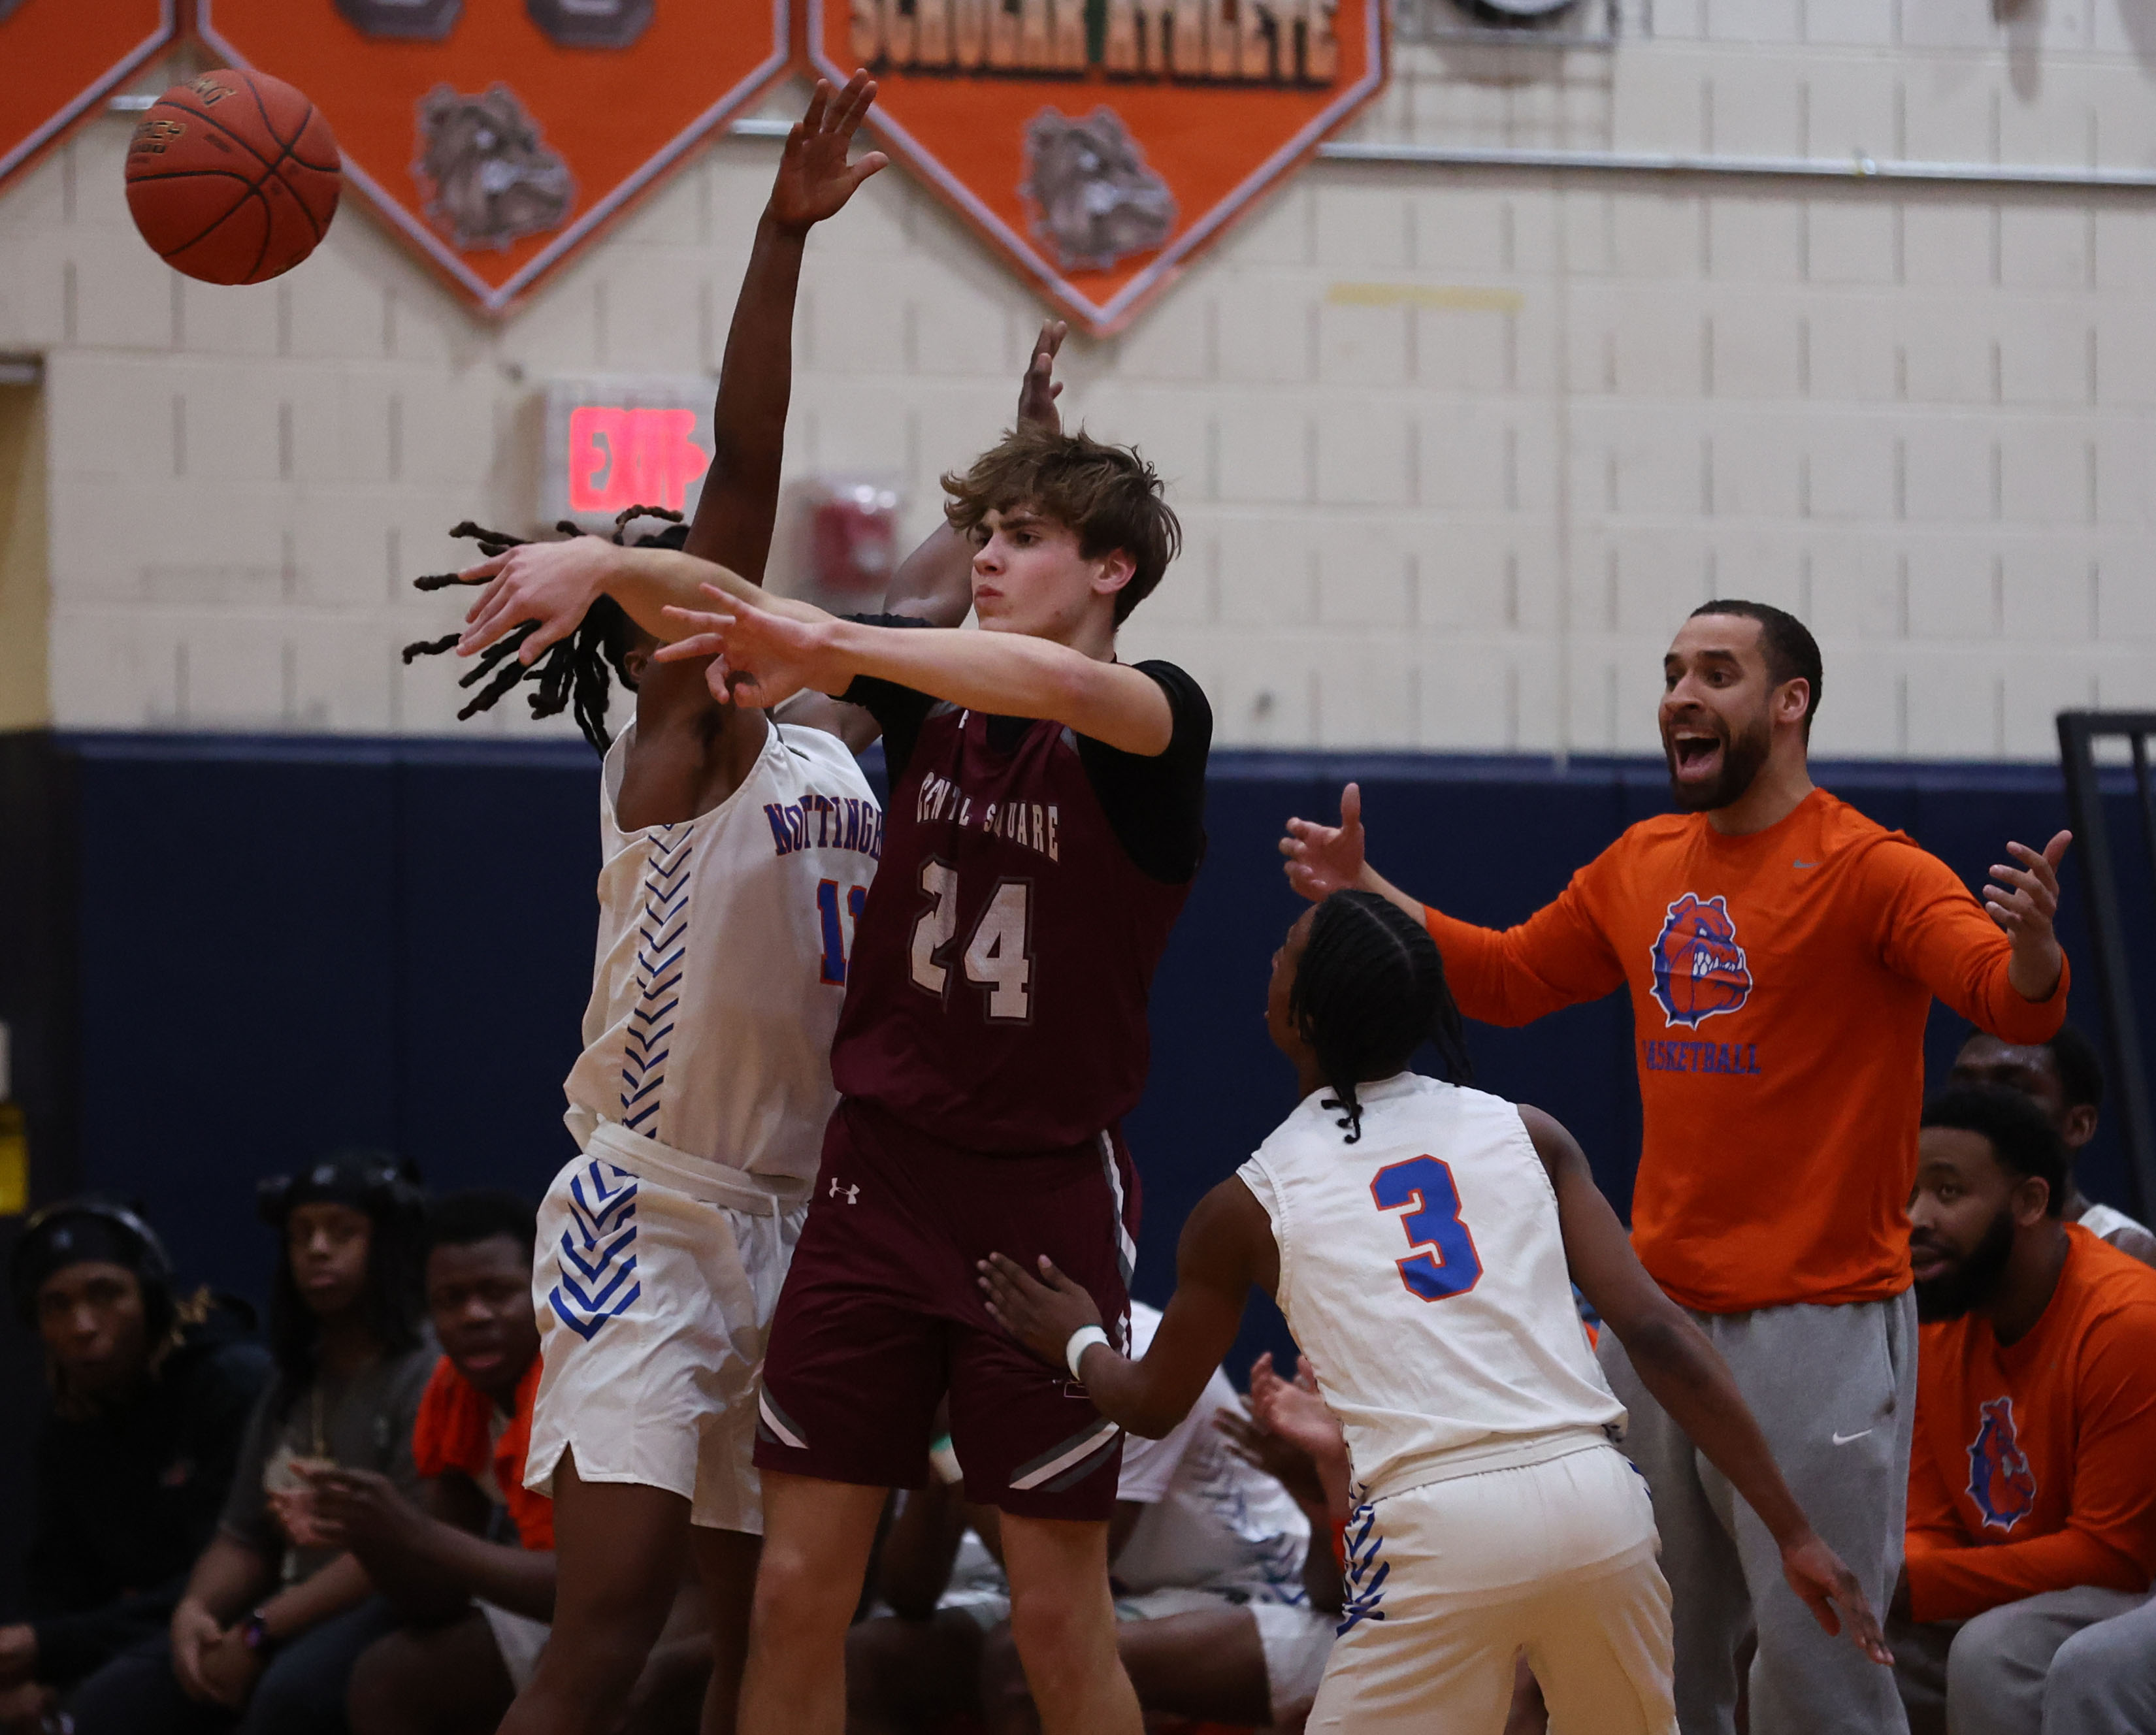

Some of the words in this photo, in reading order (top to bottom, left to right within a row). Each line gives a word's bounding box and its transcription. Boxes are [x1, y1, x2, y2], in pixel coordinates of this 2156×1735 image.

[568, 406, 696, 513] EXIT
[909, 854, 1036, 1025] 24
[1642, 1040, 1761, 1075] ASKETBALL
[1369, 1154, 1484, 1303] 3
